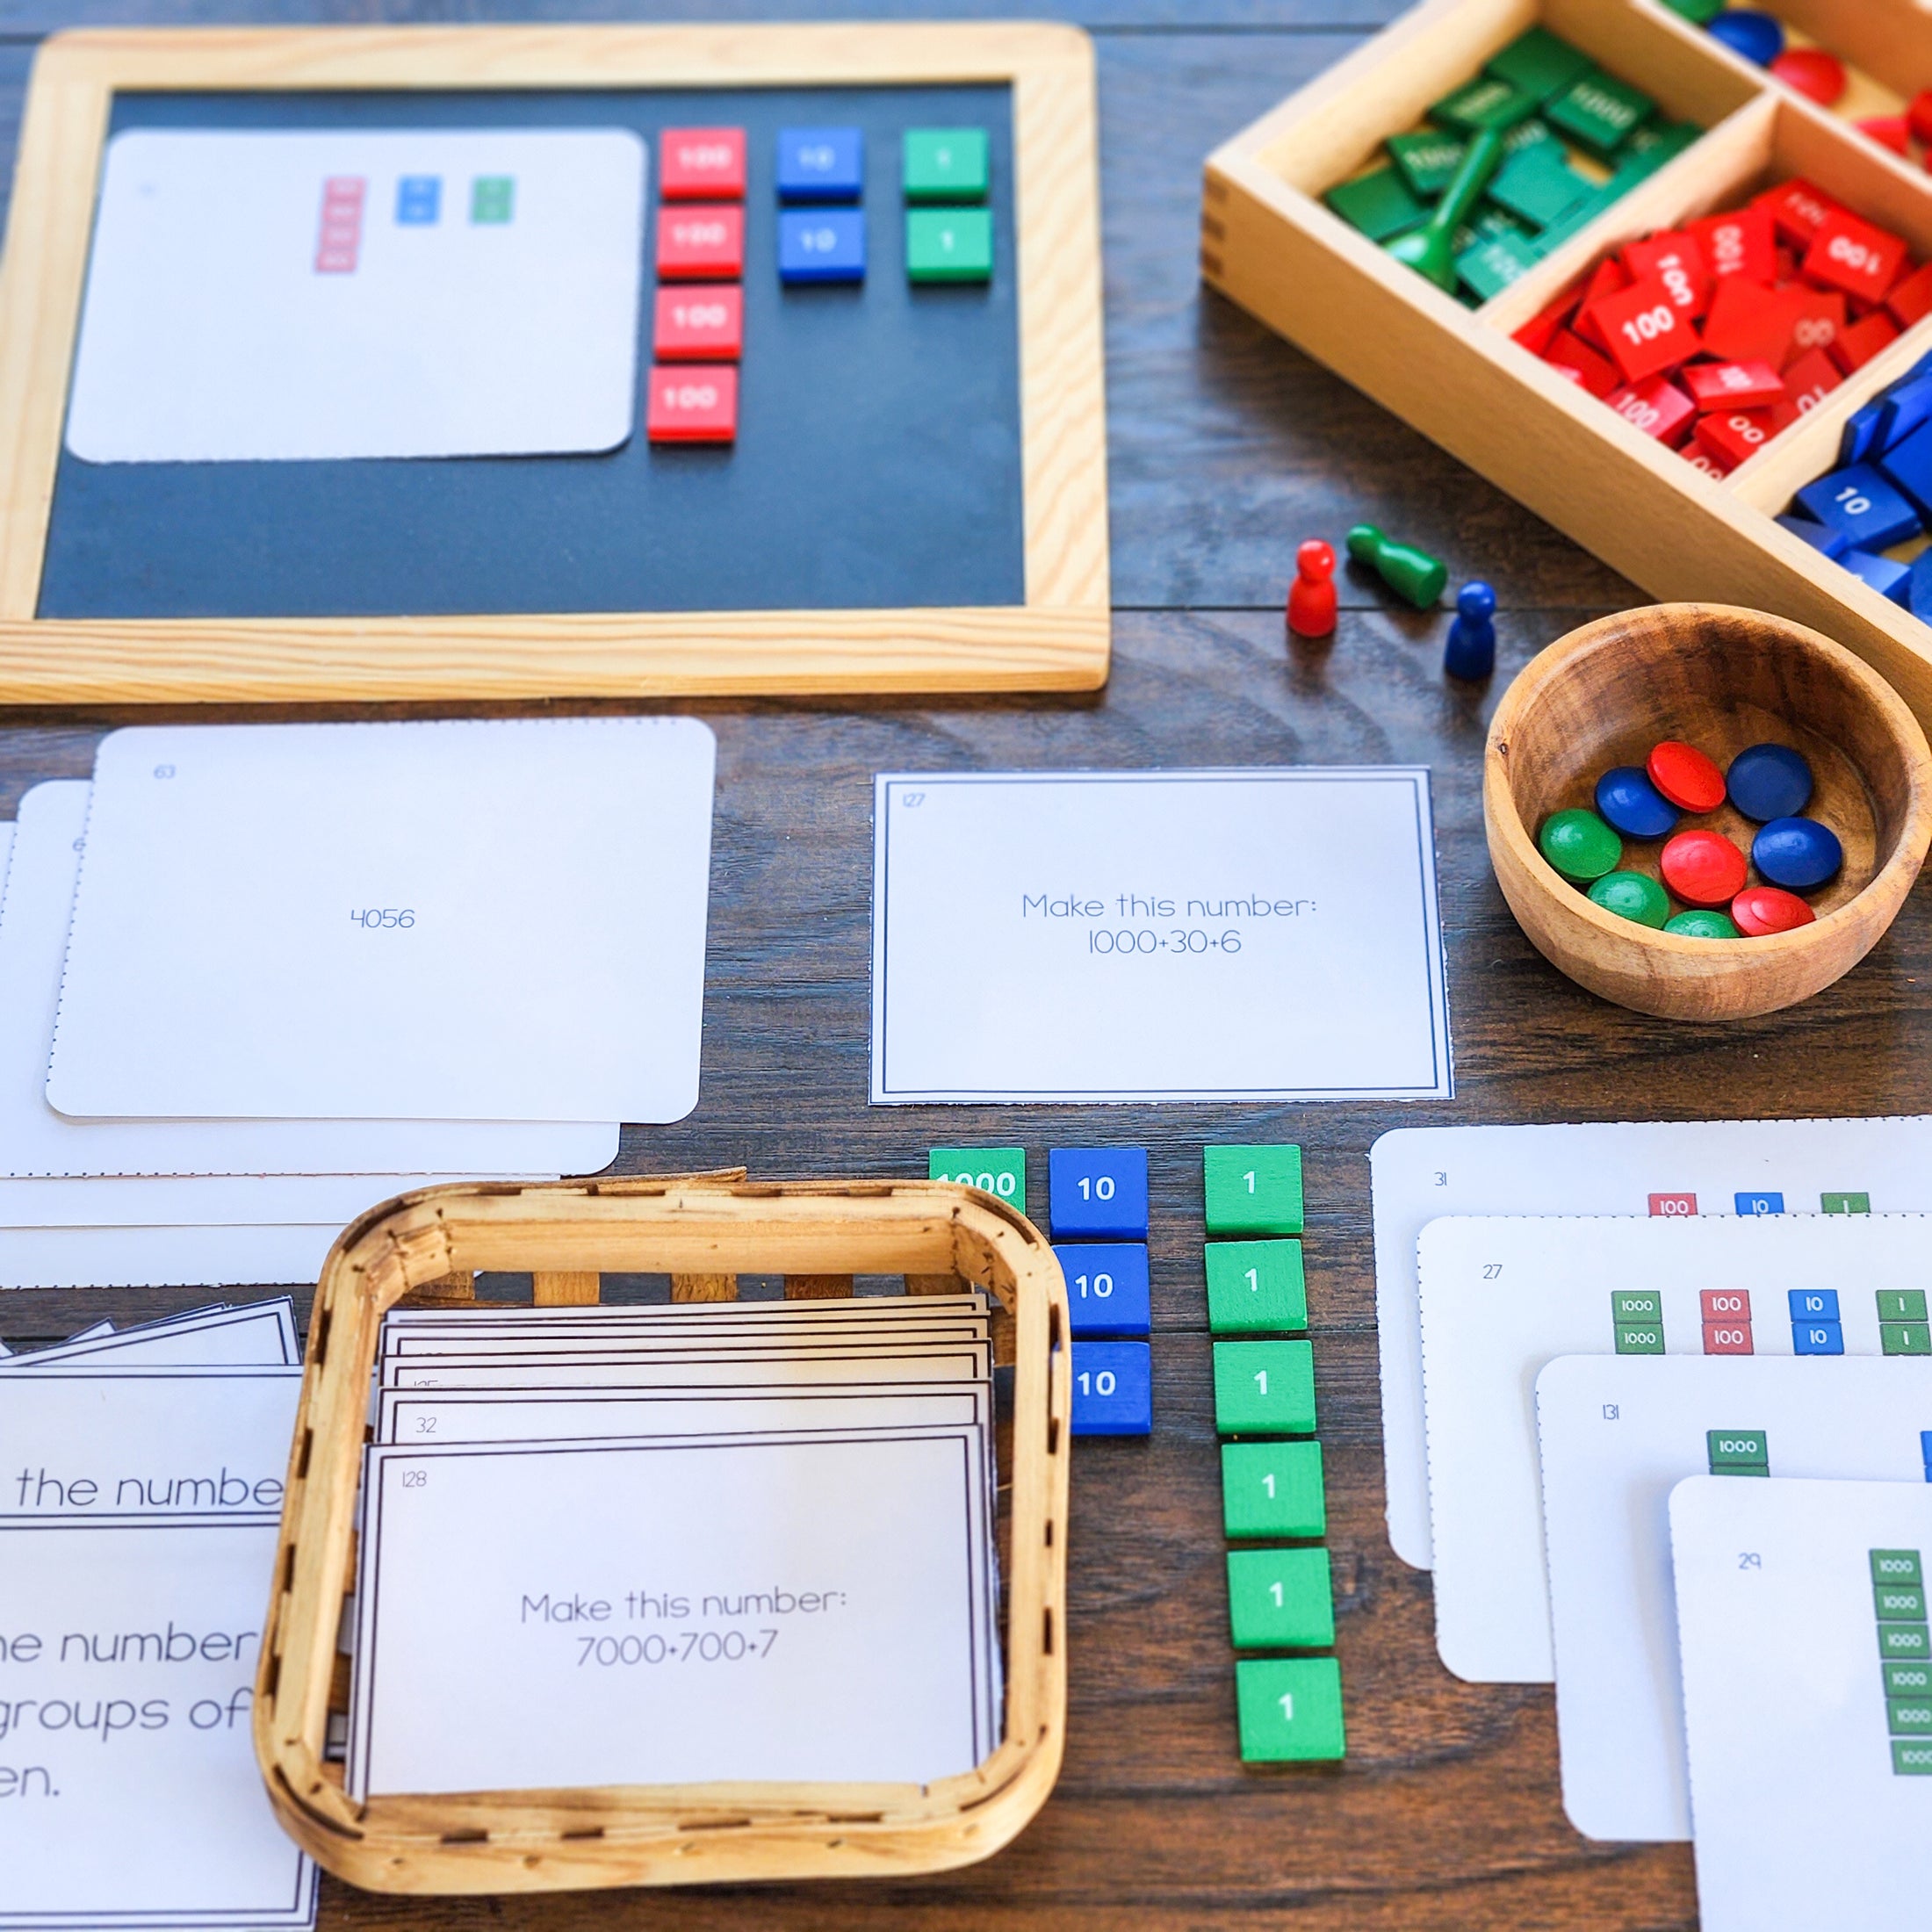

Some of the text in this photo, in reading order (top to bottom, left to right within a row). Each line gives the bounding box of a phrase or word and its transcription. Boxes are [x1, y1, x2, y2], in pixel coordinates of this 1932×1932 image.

[677, 146, 732, 169] 100
[798, 146, 834, 171] 10
[673, 222, 726, 246] 100
[800, 228, 836, 252] 10
[940, 230, 955, 251] 1
[672, 305, 726, 328] 100
[1622, 305, 1674, 345] 100
[662, 386, 717, 409] 100
[1616, 393, 1660, 429] 100
[1835, 487, 1871, 515] 10
[154, 764, 176, 779] 63
[903, 793, 925, 808] 127
[1023, 893, 1317, 917] Make this number:
[351, 908, 415, 929] 4056
[1090, 930, 1242, 954] 1000+30+6
[1078, 1177, 1115, 1200] 10
[1243, 1171, 1256, 1194] 1
[1434, 1171, 1447, 1186] 31
[1660, 1200, 1689, 1215] 100
[1752, 1200, 1769, 1214] 10
[1244, 1269, 1258, 1292] 1
[1482, 1264, 1503, 1279] 27
[1075, 1274, 1114, 1298] 10
[1622, 1300, 1653, 1311] 1000
[1712, 1296, 1741, 1311] 100
[1806, 1296, 1823, 1311] 10
[1625, 1332, 1656, 1344] 1000
[1714, 1330, 1744, 1344] 100
[1810, 1330, 1827, 1344] 10
[1078, 1371, 1116, 1395] 10
[1253, 1371, 1268, 1395] 1
[1602, 1404, 1620, 1421] 131
[415, 1417, 437, 1433] 32
[1719, 1439, 1757, 1453] 1000
[16, 1467, 284, 1507] the numbe
[402, 1471, 428, 1489] 128
[1262, 1474, 1276, 1498] 1
[1739, 1553, 1761, 1570] 29
[1879, 1560, 1914, 1573] 1000
[522, 1585, 847, 1624] Make this number:
[1268, 1582, 1284, 1607] 1
[1884, 1596, 1918, 1609] 1000
[0, 1621, 259, 1662] e number
[577, 1629, 778, 1667] 7000+700+7
[1888, 1634, 1922, 1647] 1000
[1892, 1672, 1927, 1685] 1000
[189, 1686, 255, 1730] of
[1278, 1694, 1293, 1719] 1
[1897, 1709, 1932, 1723] 1000
